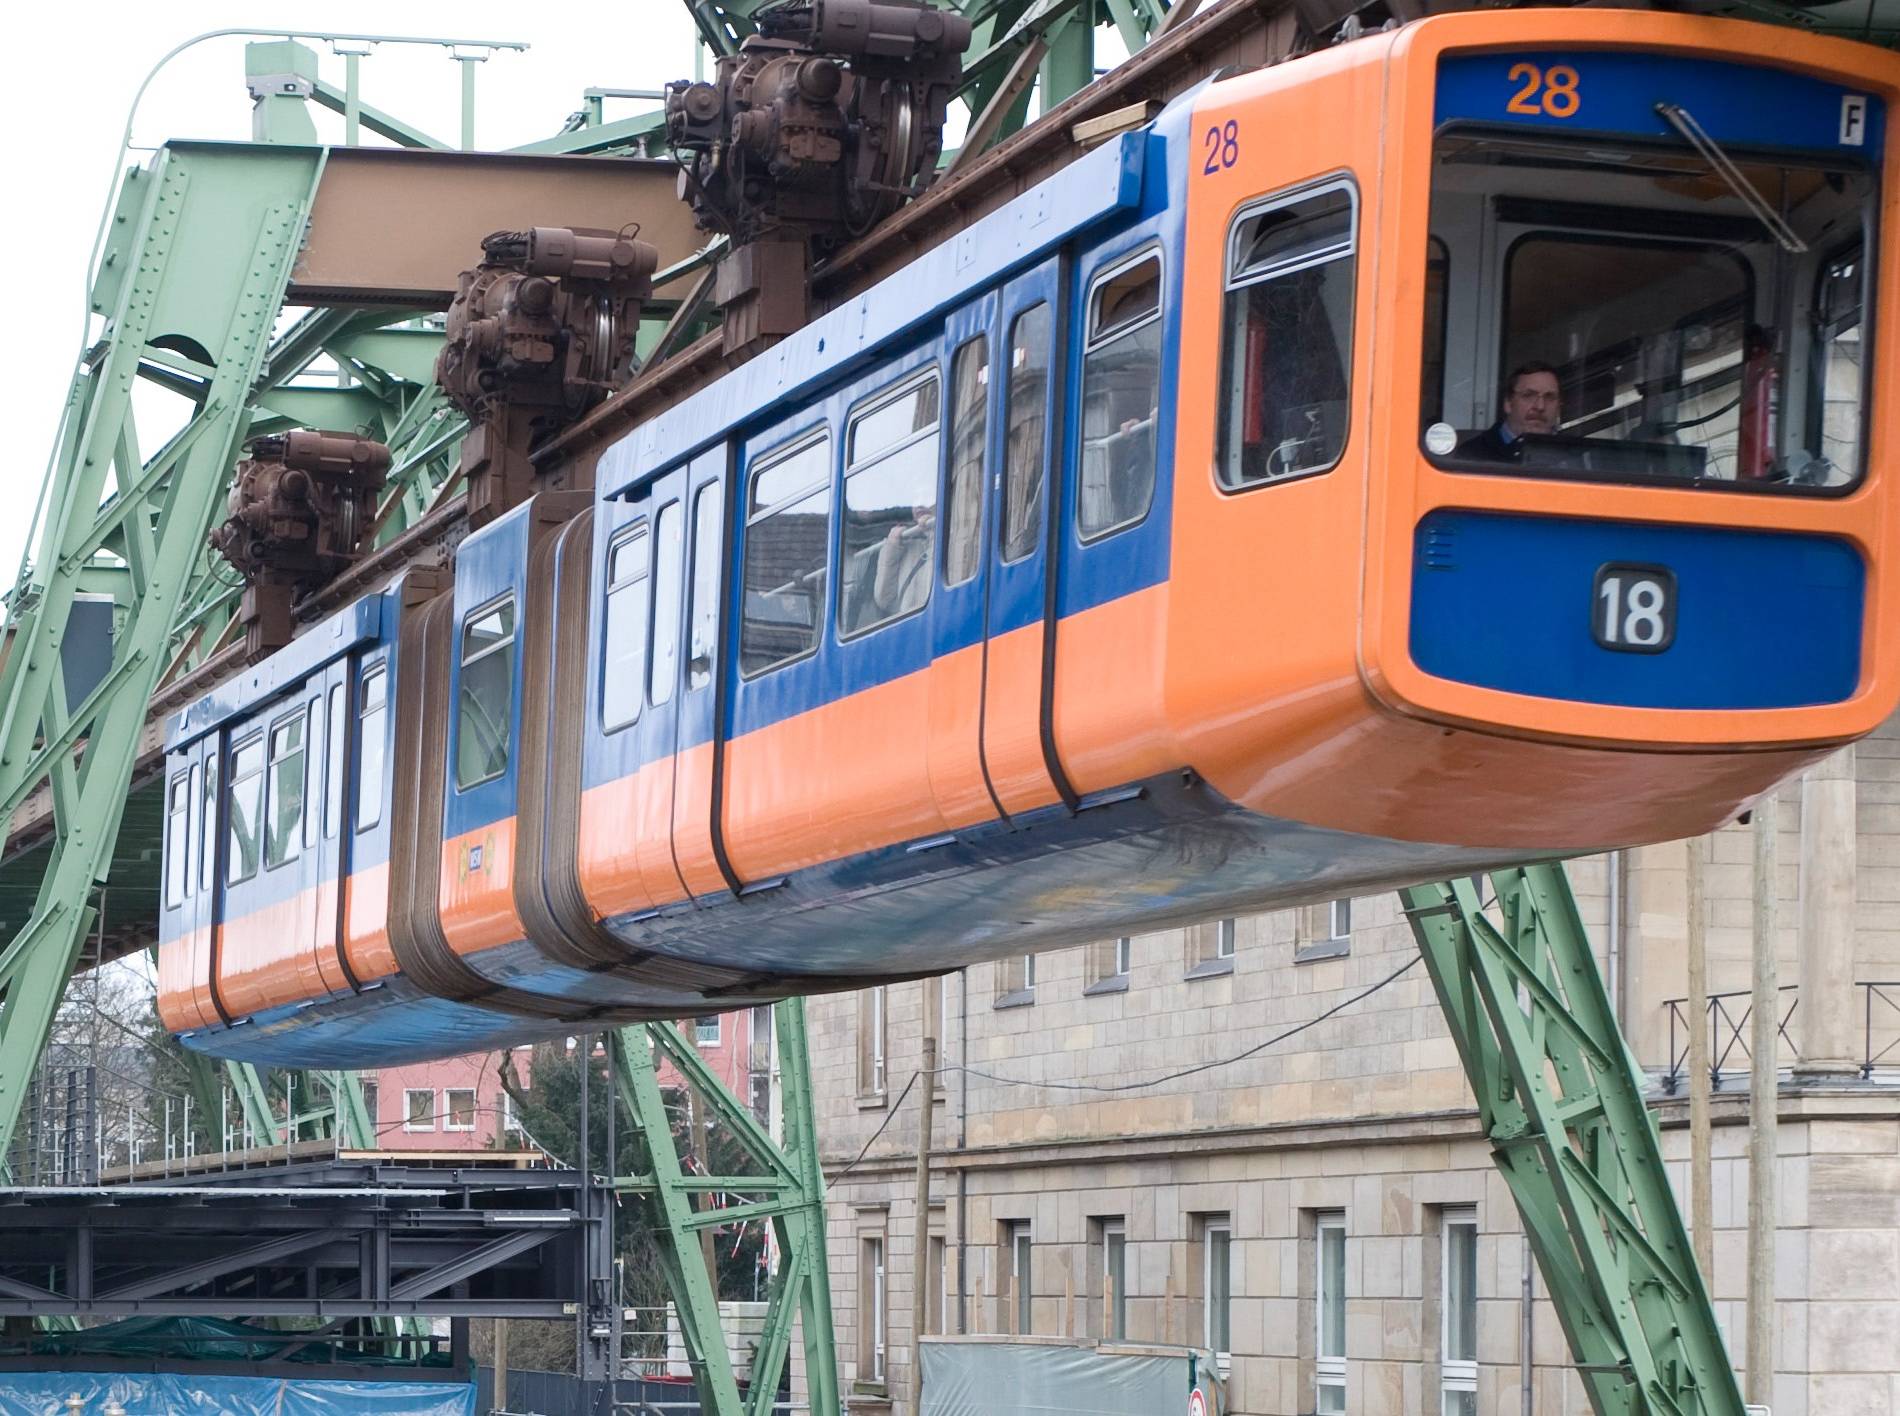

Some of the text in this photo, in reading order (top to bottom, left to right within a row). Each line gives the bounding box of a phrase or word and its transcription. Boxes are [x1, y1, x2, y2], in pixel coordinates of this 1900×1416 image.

[1506, 63, 1581, 118] 28
[1203, 119, 1239, 176] 28
[1844, 104, 1861, 138] F
[1600, 577, 1664, 645] 18
